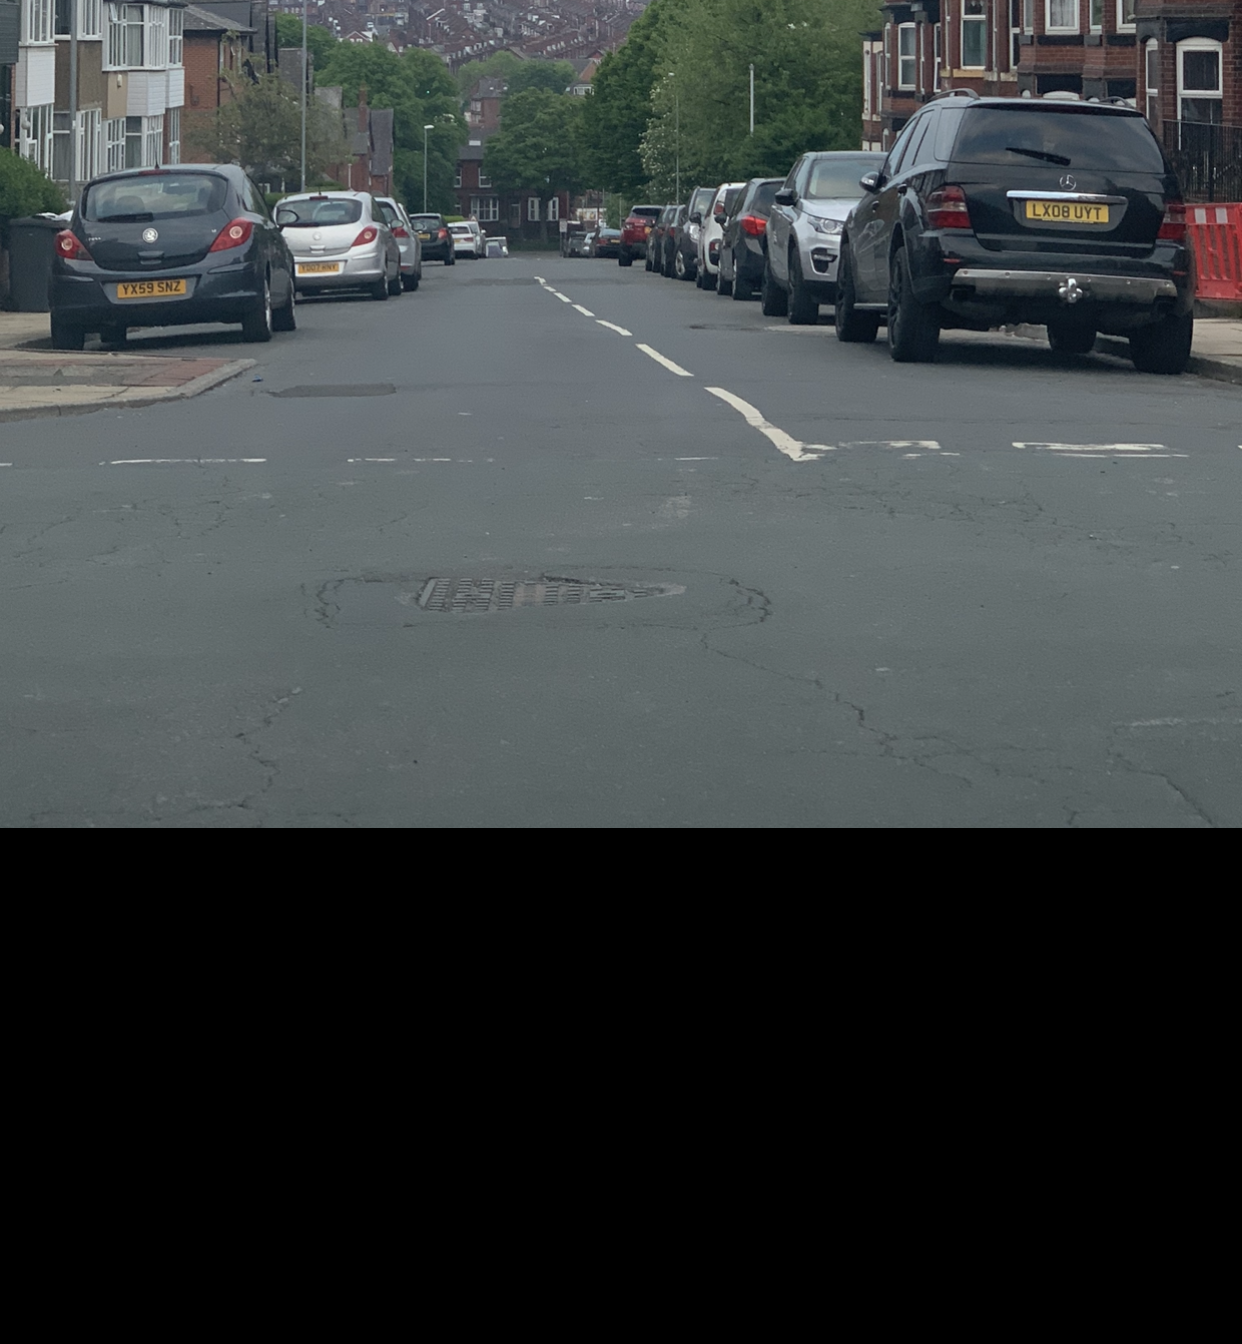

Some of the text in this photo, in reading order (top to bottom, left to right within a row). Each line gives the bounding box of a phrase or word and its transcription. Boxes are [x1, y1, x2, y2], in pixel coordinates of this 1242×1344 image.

[1032, 203, 1102, 220] LX08 UYT
[122, 280, 181, 295] YX59 SNZ
